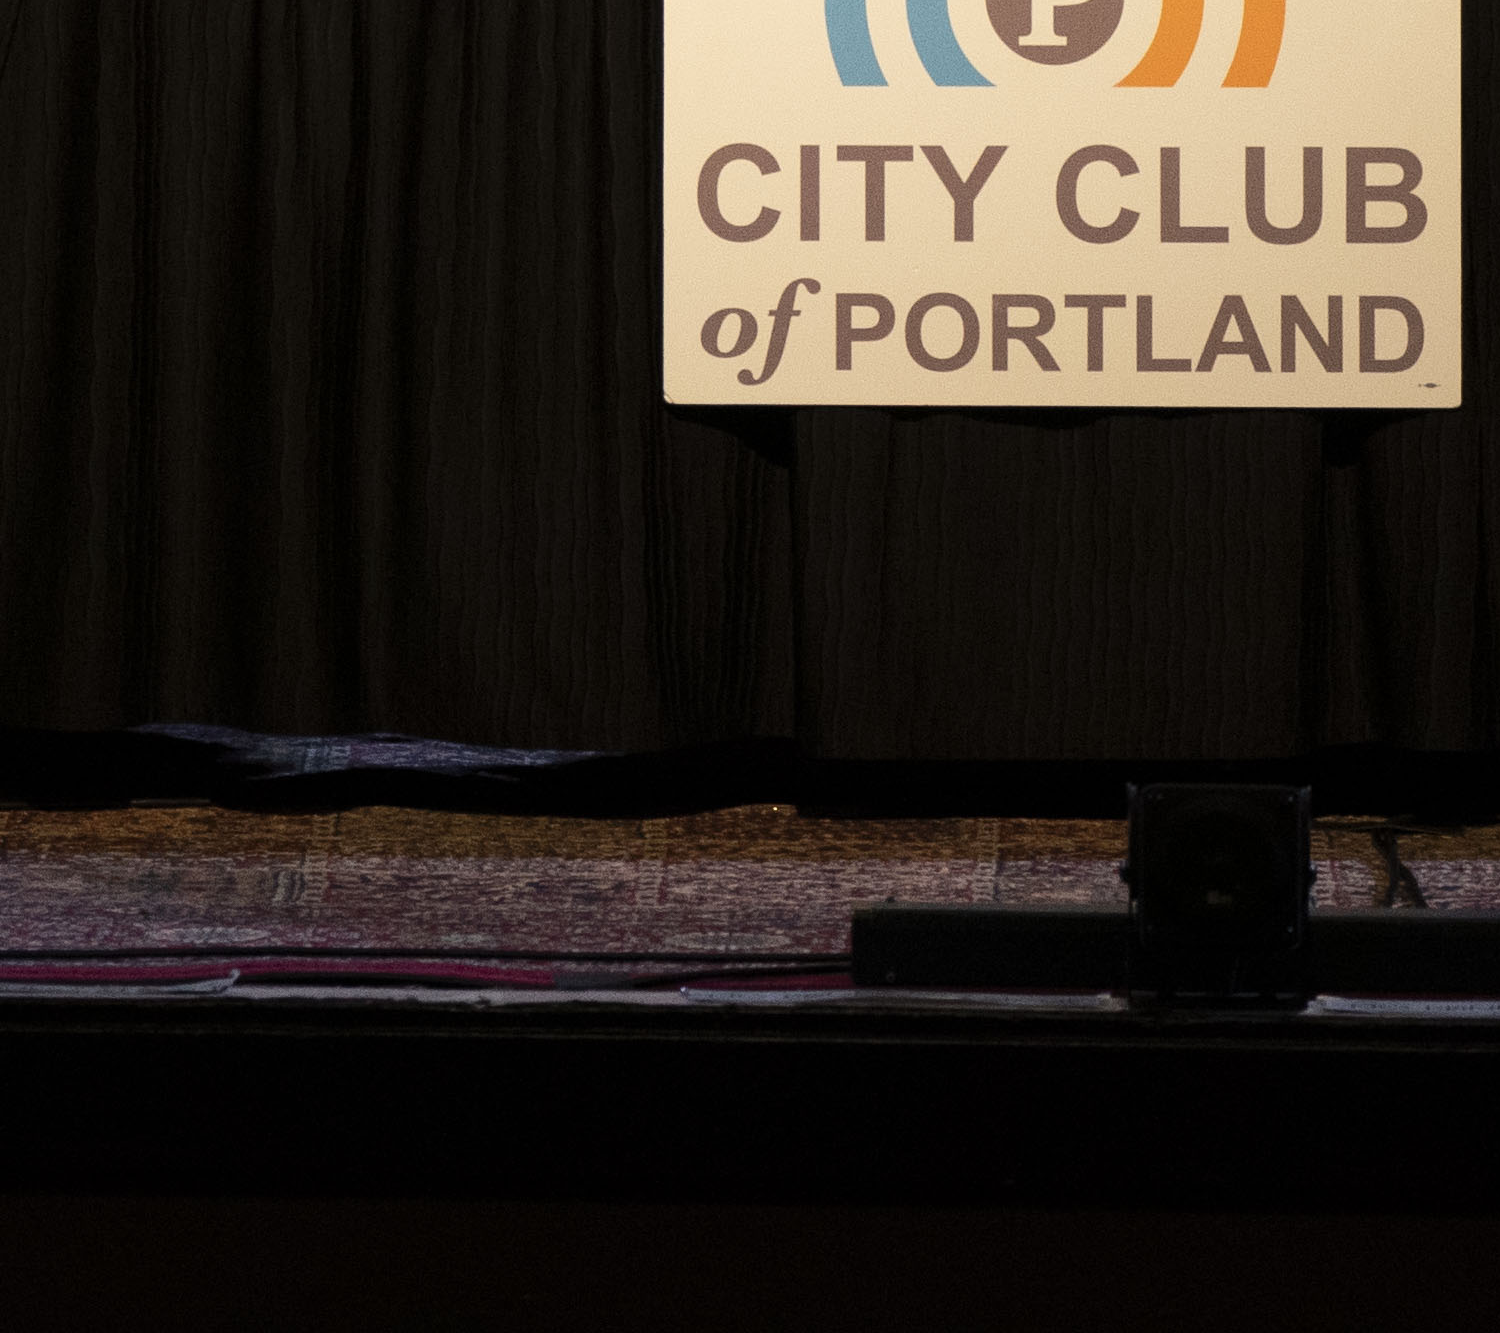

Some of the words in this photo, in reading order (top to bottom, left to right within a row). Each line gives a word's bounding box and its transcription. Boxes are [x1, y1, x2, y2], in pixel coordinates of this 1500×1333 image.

[696, 142, 1009, 243] CITY
[1055, 144, 1429, 246] CLUB
[700, 277, 822, 387] of
[834, 291, 1426, 374] PORTLAND
